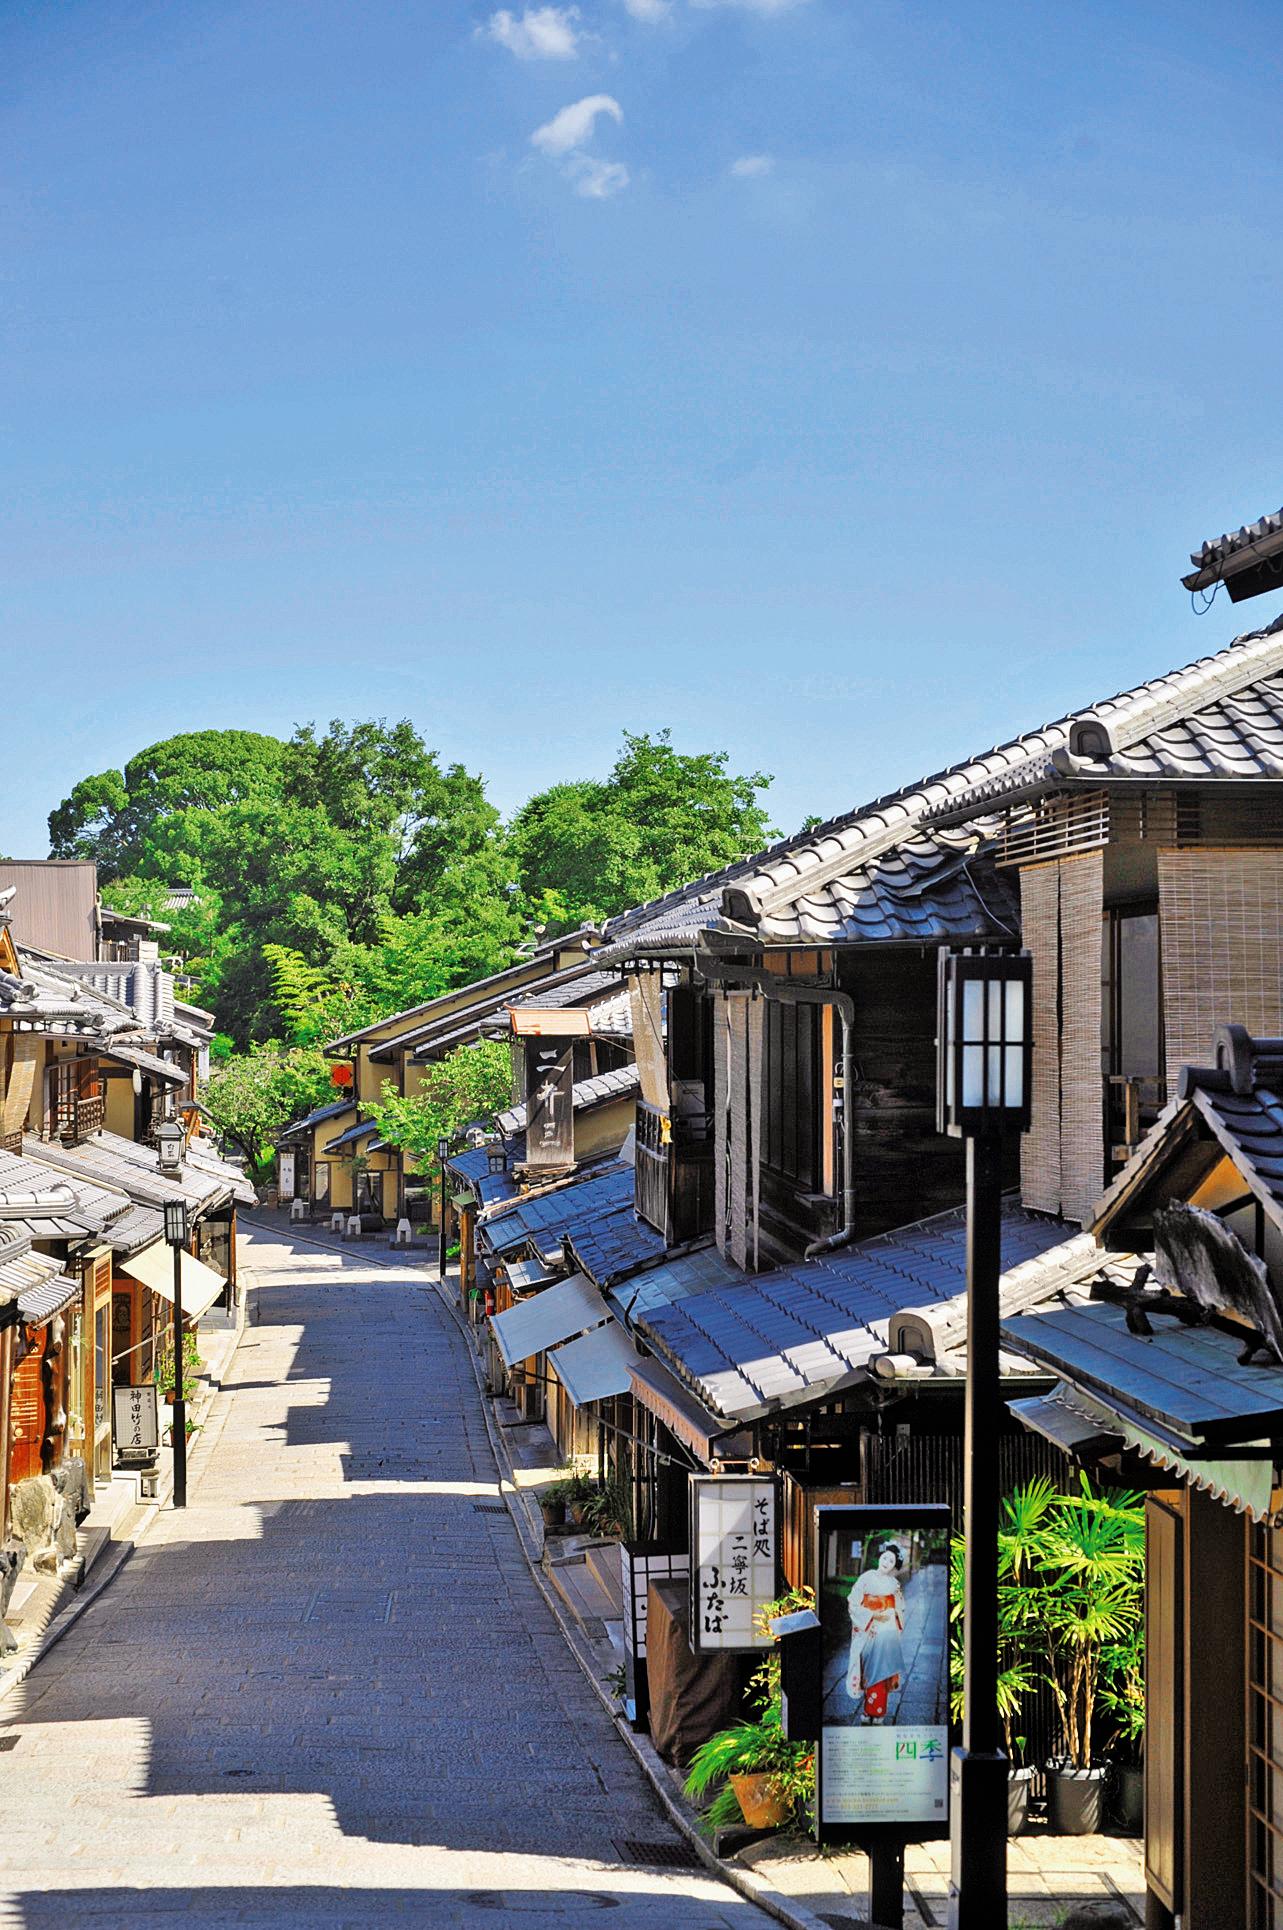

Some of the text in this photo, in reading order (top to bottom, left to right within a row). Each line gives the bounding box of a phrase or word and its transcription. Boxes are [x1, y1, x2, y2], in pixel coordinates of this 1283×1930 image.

[129, 1390, 142, 1445] 神田竹の店
[753, 1497, 771, 1558] そば処
[729, 1535, 749, 1596] 二寧坂
[703, 1566, 728, 1634] ふたば
[896, 1739, 944, 1762] 四季
